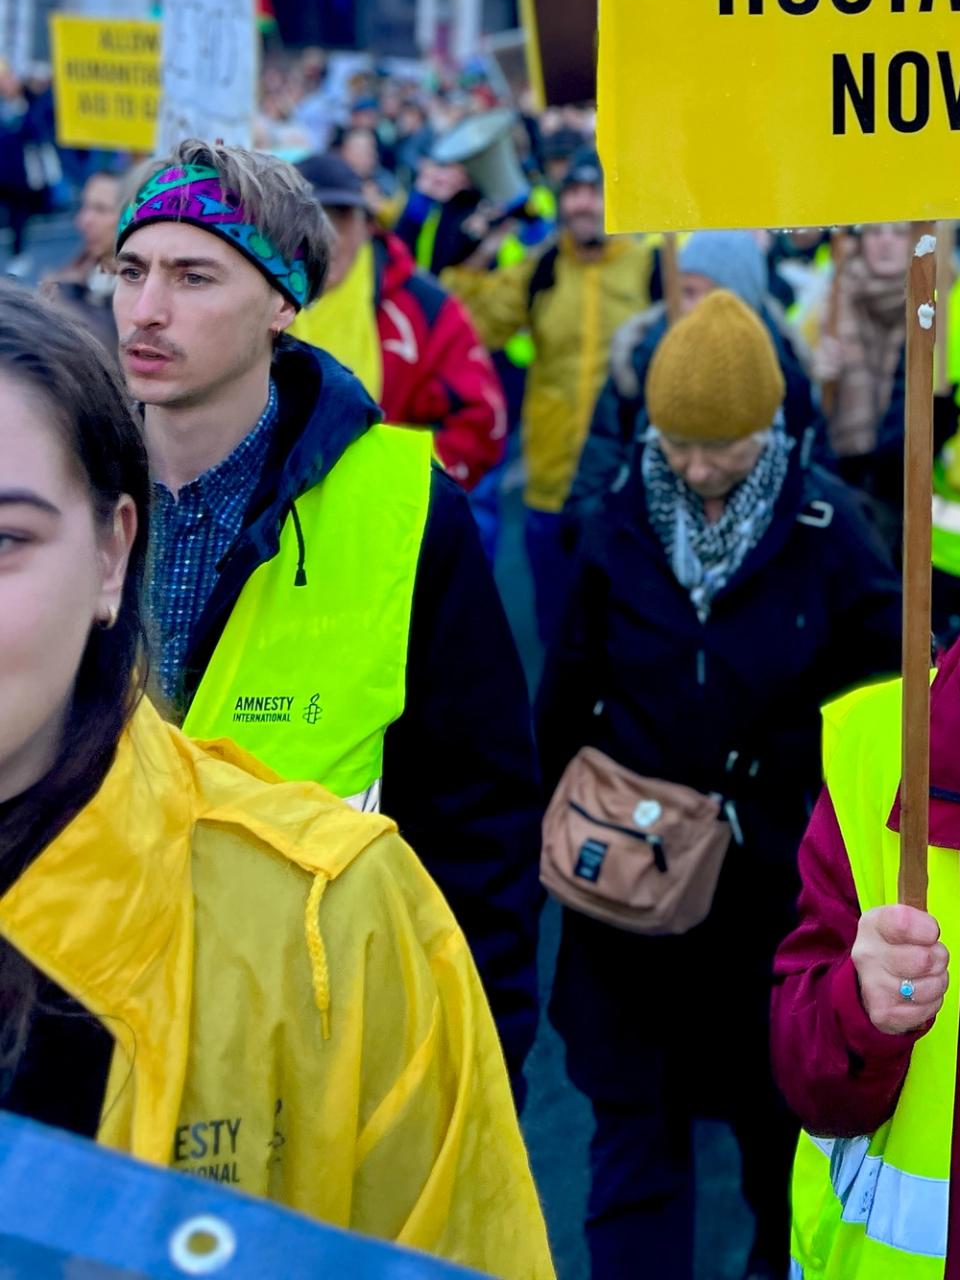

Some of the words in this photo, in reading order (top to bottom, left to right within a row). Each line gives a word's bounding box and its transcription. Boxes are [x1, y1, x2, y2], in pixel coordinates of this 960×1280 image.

[235, 697, 294, 711] AMNESTY
[233, 713, 291, 722] INTERNATIONAL
[174, 1117, 242, 1161] ESTY
